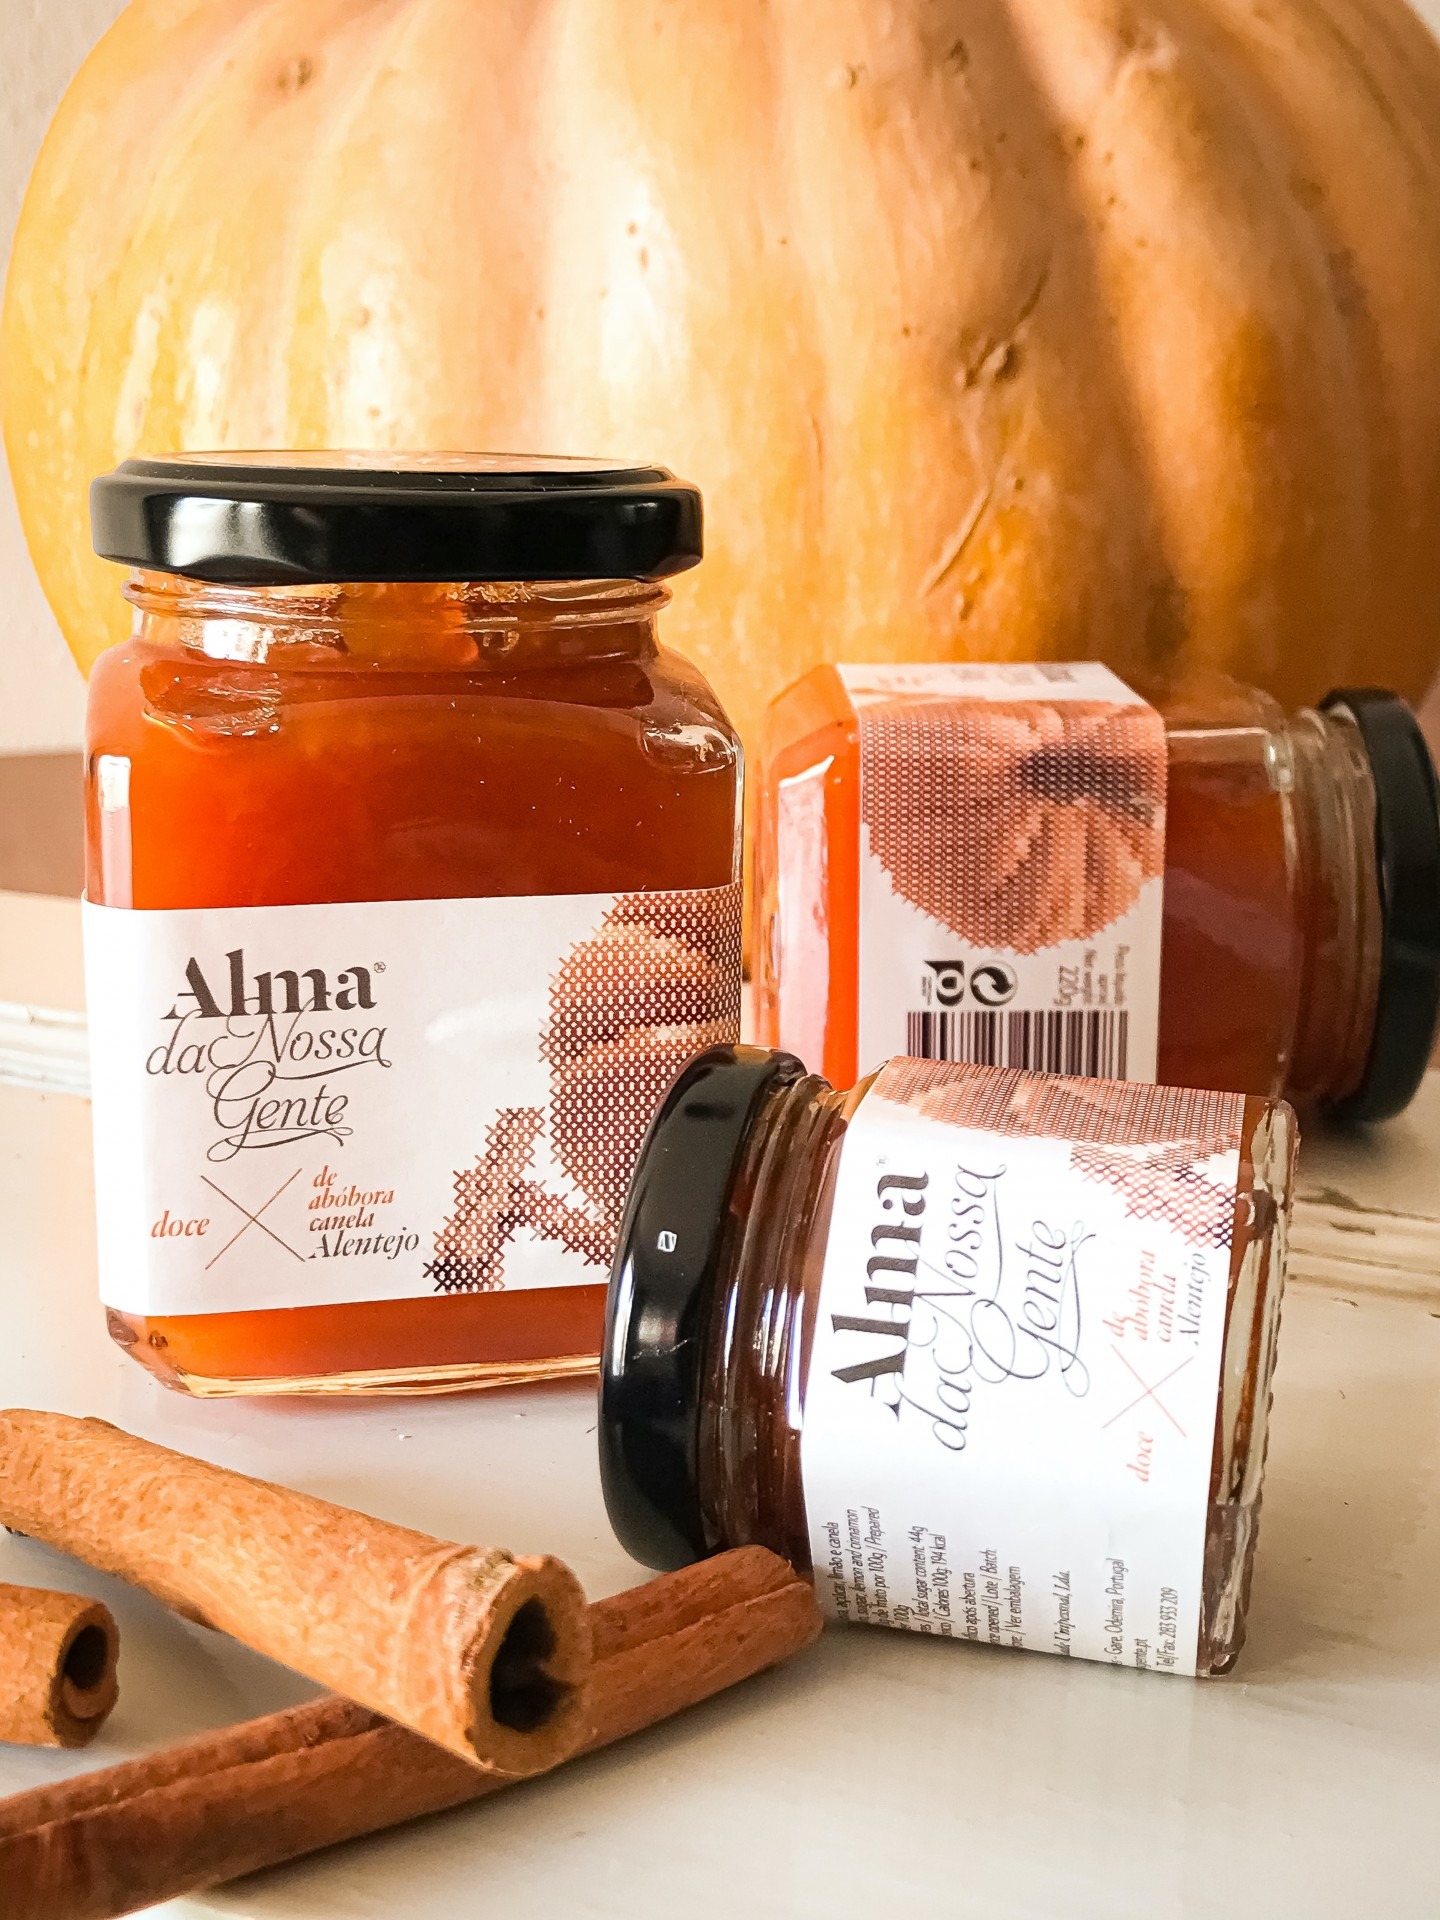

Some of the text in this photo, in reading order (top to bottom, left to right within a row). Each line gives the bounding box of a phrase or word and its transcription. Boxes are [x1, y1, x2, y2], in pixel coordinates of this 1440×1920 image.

[146, 998, 392, 1080] da Nossa
[206, 1060, 353, 1163] Gente
[312, 1165, 338, 1188] de
[308, 1185, 394, 1210] abóbora
[151, 1210, 210, 1238] doce
[309, 1206, 375, 1232] canela
[308, 1227, 420, 1260] Alentejo
[893, 1164, 1006, 1451] da Nossa
[970, 1220, 1096, 1398] Gente
[1153, 1273, 1177, 1343] canela
[1178, 1253, 1211, 1346] Alentejo
[1102, 1312, 1125, 1338] de
[1126, 1431, 1154, 1483] doce
[821, 1521, 840, 1548] canela
[846, 1509, 862, 1549] cinnamon
[861, 1506, 885, 1546] Prepared
[908, 1526, 928, 1543] 44g
[929, 1533, 946, 1550] kcal
[845, 1549, 863, 1567] and
[868, 1552, 888, 1572] 100g
[929, 1552, 947, 1566] 194
[849, 1567, 865, 1592] lemon
[874, 1574, 890, 1589] por
[916, 1578, 932, 1600] sugar
[959, 1572, 976, 1605] abertura
[1105, 1558, 1129, 1596] Portugal
[871, 1589, 887, 1608] fruto
[981, 1581, 999, 1599] Lote
[1003, 1566, 1026, 1614] embalagem
[1160, 1587, 1178, 1605] 209
[912, 1598, 930, 1618] Total
[1159, 1606, 1177, 1621] 933
[1004, 1615, 1022, 1628] Ver
[1158, 1622, 1176, 1638] 283
